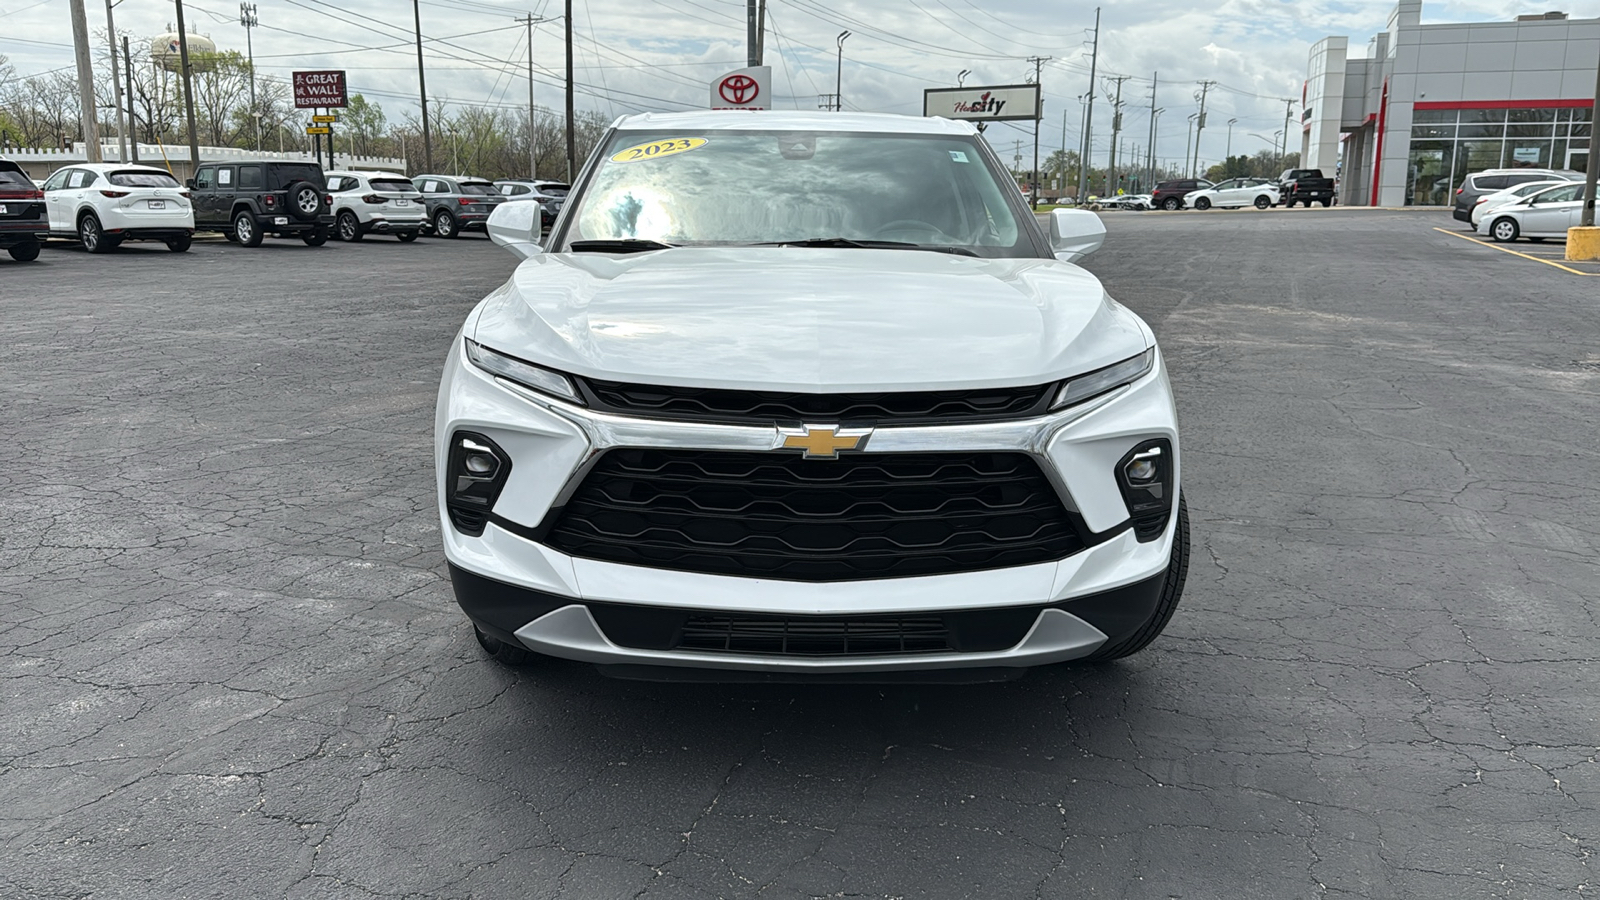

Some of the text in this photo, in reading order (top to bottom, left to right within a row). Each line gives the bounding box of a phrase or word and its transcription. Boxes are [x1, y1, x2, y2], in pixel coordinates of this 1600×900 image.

[305, 74, 339, 84] GREAT
[307, 85, 339, 95] WALL
[296, 97, 342, 105] RESTAURANT
[628, 139, 691, 160] 2023
